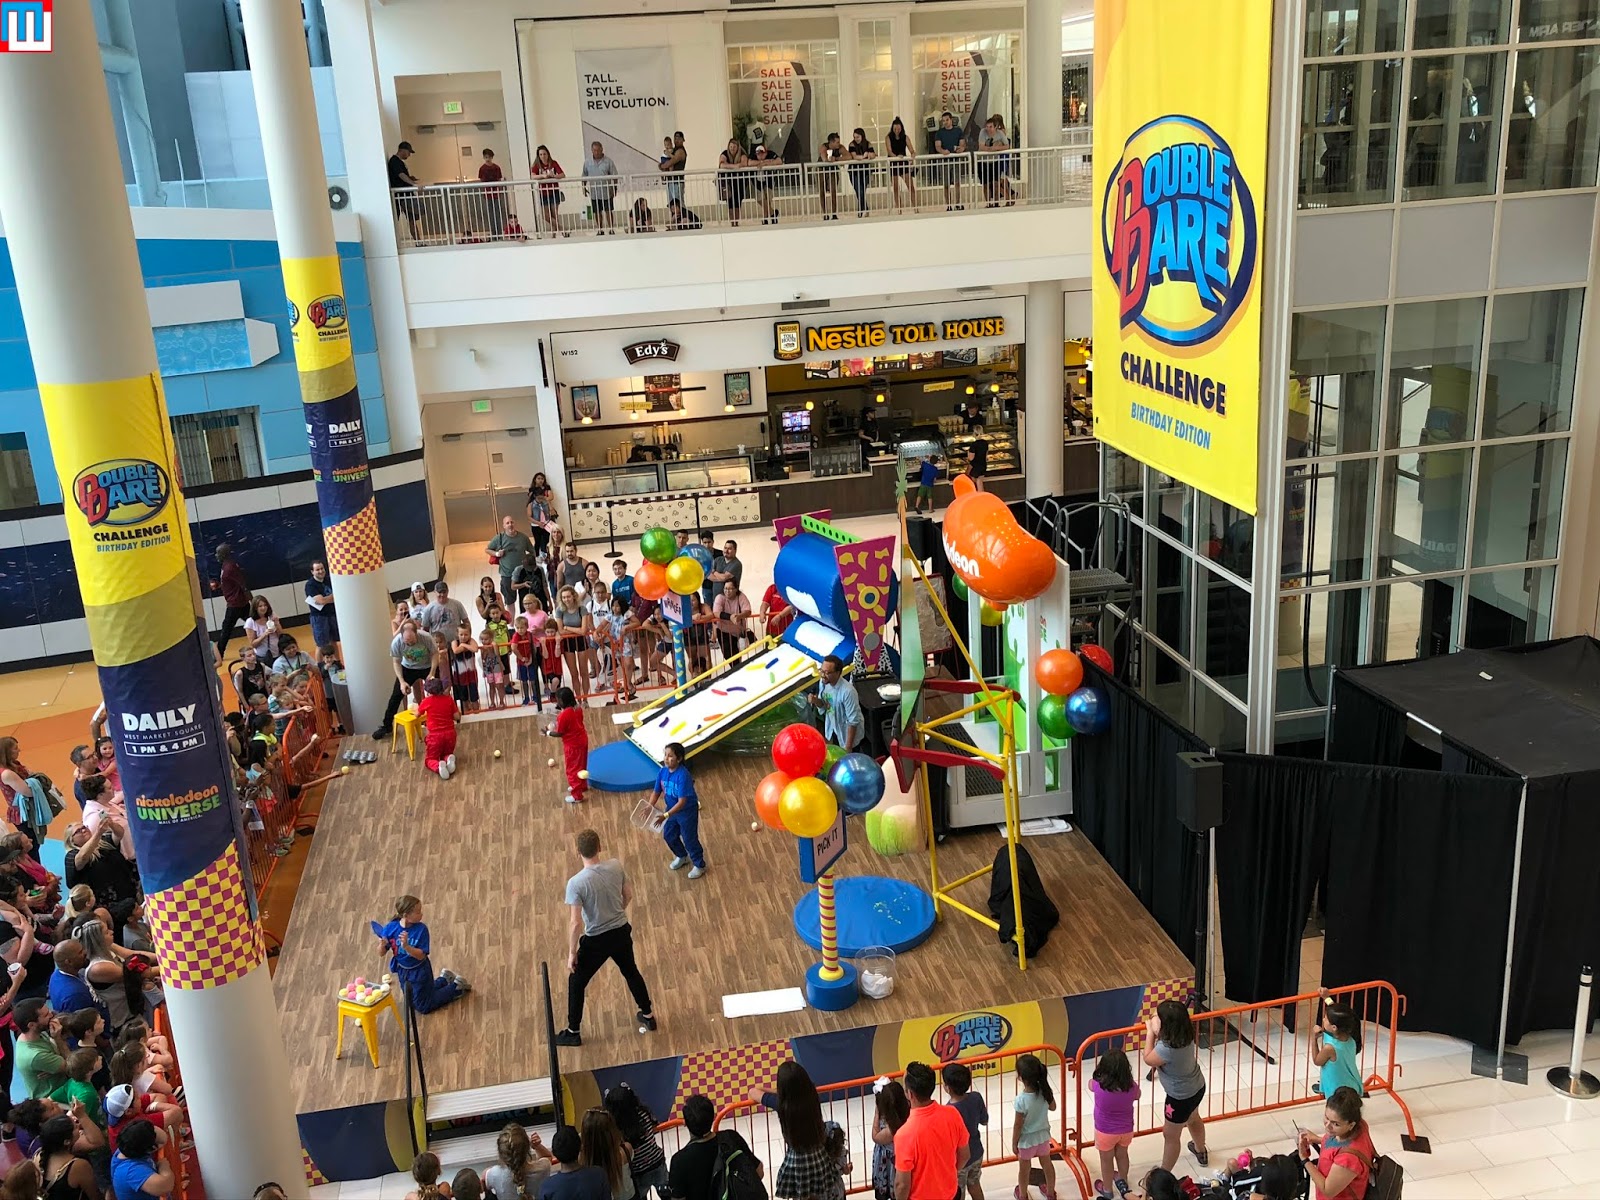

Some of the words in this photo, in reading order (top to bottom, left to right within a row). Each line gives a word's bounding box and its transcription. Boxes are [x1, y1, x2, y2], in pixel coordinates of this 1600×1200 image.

[941, 58, 970, 68] SALE
[584, 73, 617, 83] TALL.
[760, 67, 791, 78] SALE
[941, 70, 970, 80] SALE
[586, 86, 626, 97] STYLE.
[761, 80, 792, 90] SALE
[942, 82, 971, 92] SALE
[587, 97, 669, 111] REVOLUTION.
[762, 91, 792, 102] SALE
[763, 103, 793, 113] SALE
[763, 114, 793, 125] SALE
[1111, 144, 1230, 274] DOUBLE
[1120, 199, 1229, 318] DARE
[311, 298, 345, 322] DOUBL
[808, 321, 886, 351] Nestlé
[890, 323, 938, 344] TOLL
[942, 316, 1005, 340] HOUSE
[635, 343, 668, 357] Edy's
[1120, 351, 1226, 416] CHALLENGE
[329, 420, 360, 434] DAILY
[1131, 402, 1173, 433] BIRTHDAY
[1174, 420, 1211, 450] EDITION
[78, 464, 157, 511] DOUBLE
[87, 479, 161, 524] DARE
[93, 523, 169, 541] CHALLENGE
[96, 541, 138, 552] BIRTHDAY
[140, 535, 171, 547] EDITION
[122, 703, 196, 732] DAILY
[142, 731, 171, 740] MARKET
[174, 723, 202, 736] SQUARE
[131, 745, 137, 753] 1
[140, 745, 156, 753] PM
[160, 744, 168, 752] &
[171, 742, 179, 750] 4
[182, 737, 198, 748] PM
[135, 785, 219, 807] nickelodeon
[137, 794, 221, 821] UNIVERSE
[817, 835, 831, 856] PICK
[832, 827, 838, 841] IT
[936, 1016, 1000, 1053] DOUBLE
[940, 1027, 1001, 1062] DARE
